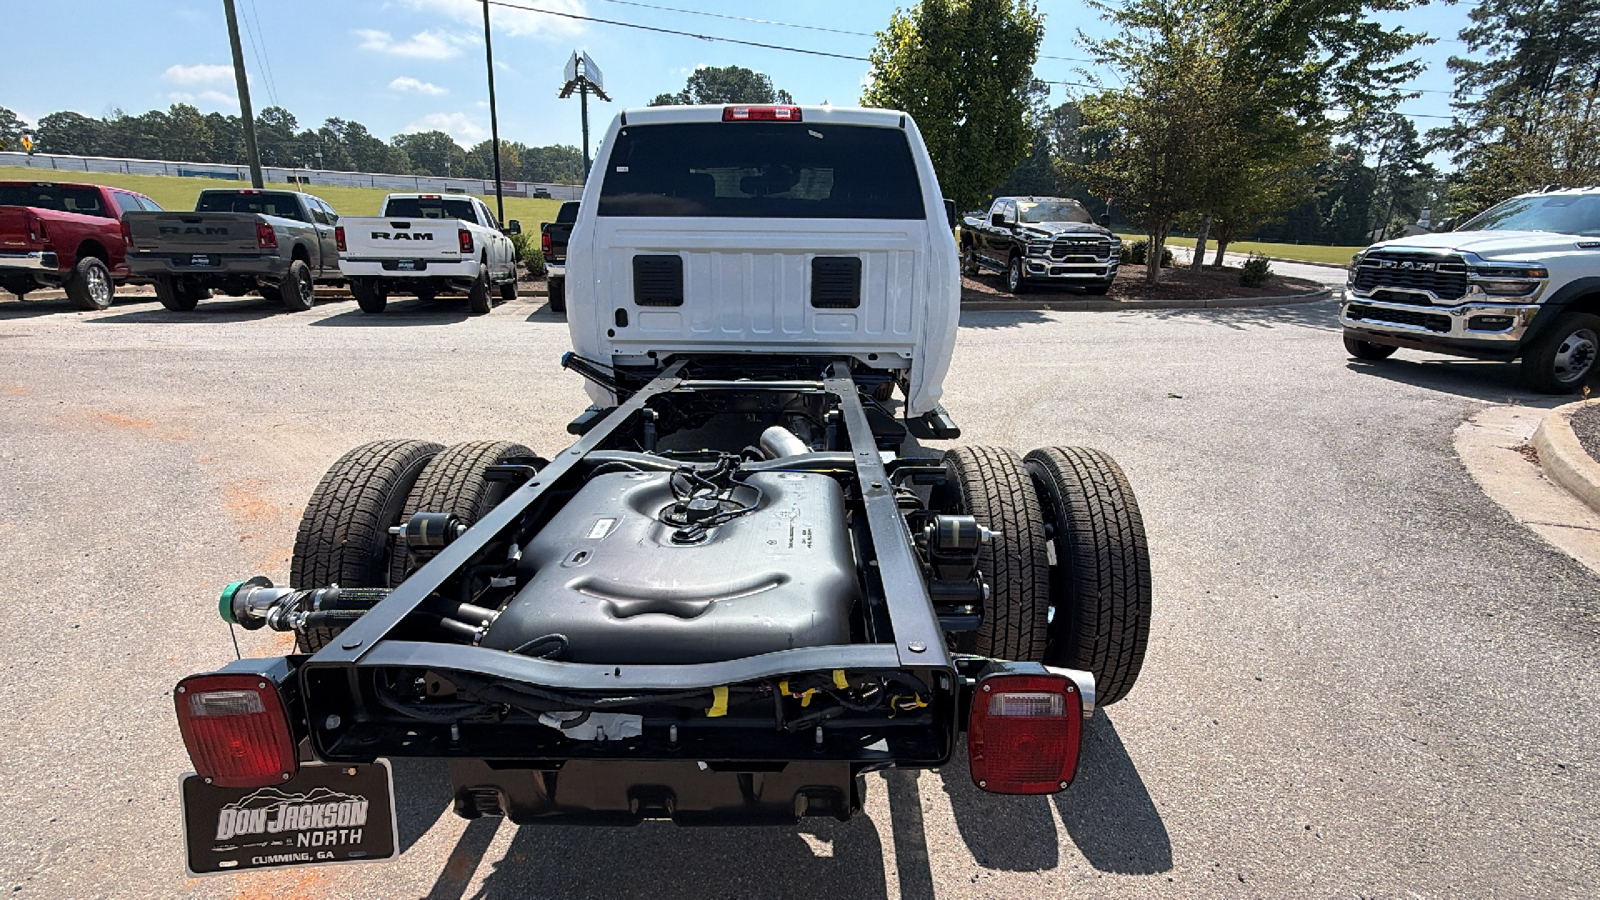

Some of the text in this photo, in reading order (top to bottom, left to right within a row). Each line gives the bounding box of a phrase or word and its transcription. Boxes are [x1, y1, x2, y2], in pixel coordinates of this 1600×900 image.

[158, 226, 229, 236] RAM
[371, 231, 434, 241] RAM
[1381, 260, 1436, 272] RAM
[215, 801, 369, 841] DON JACKSON
[297, 829, 362, 848] NORTH
[252, 851, 335, 865] CUMMING, GA
